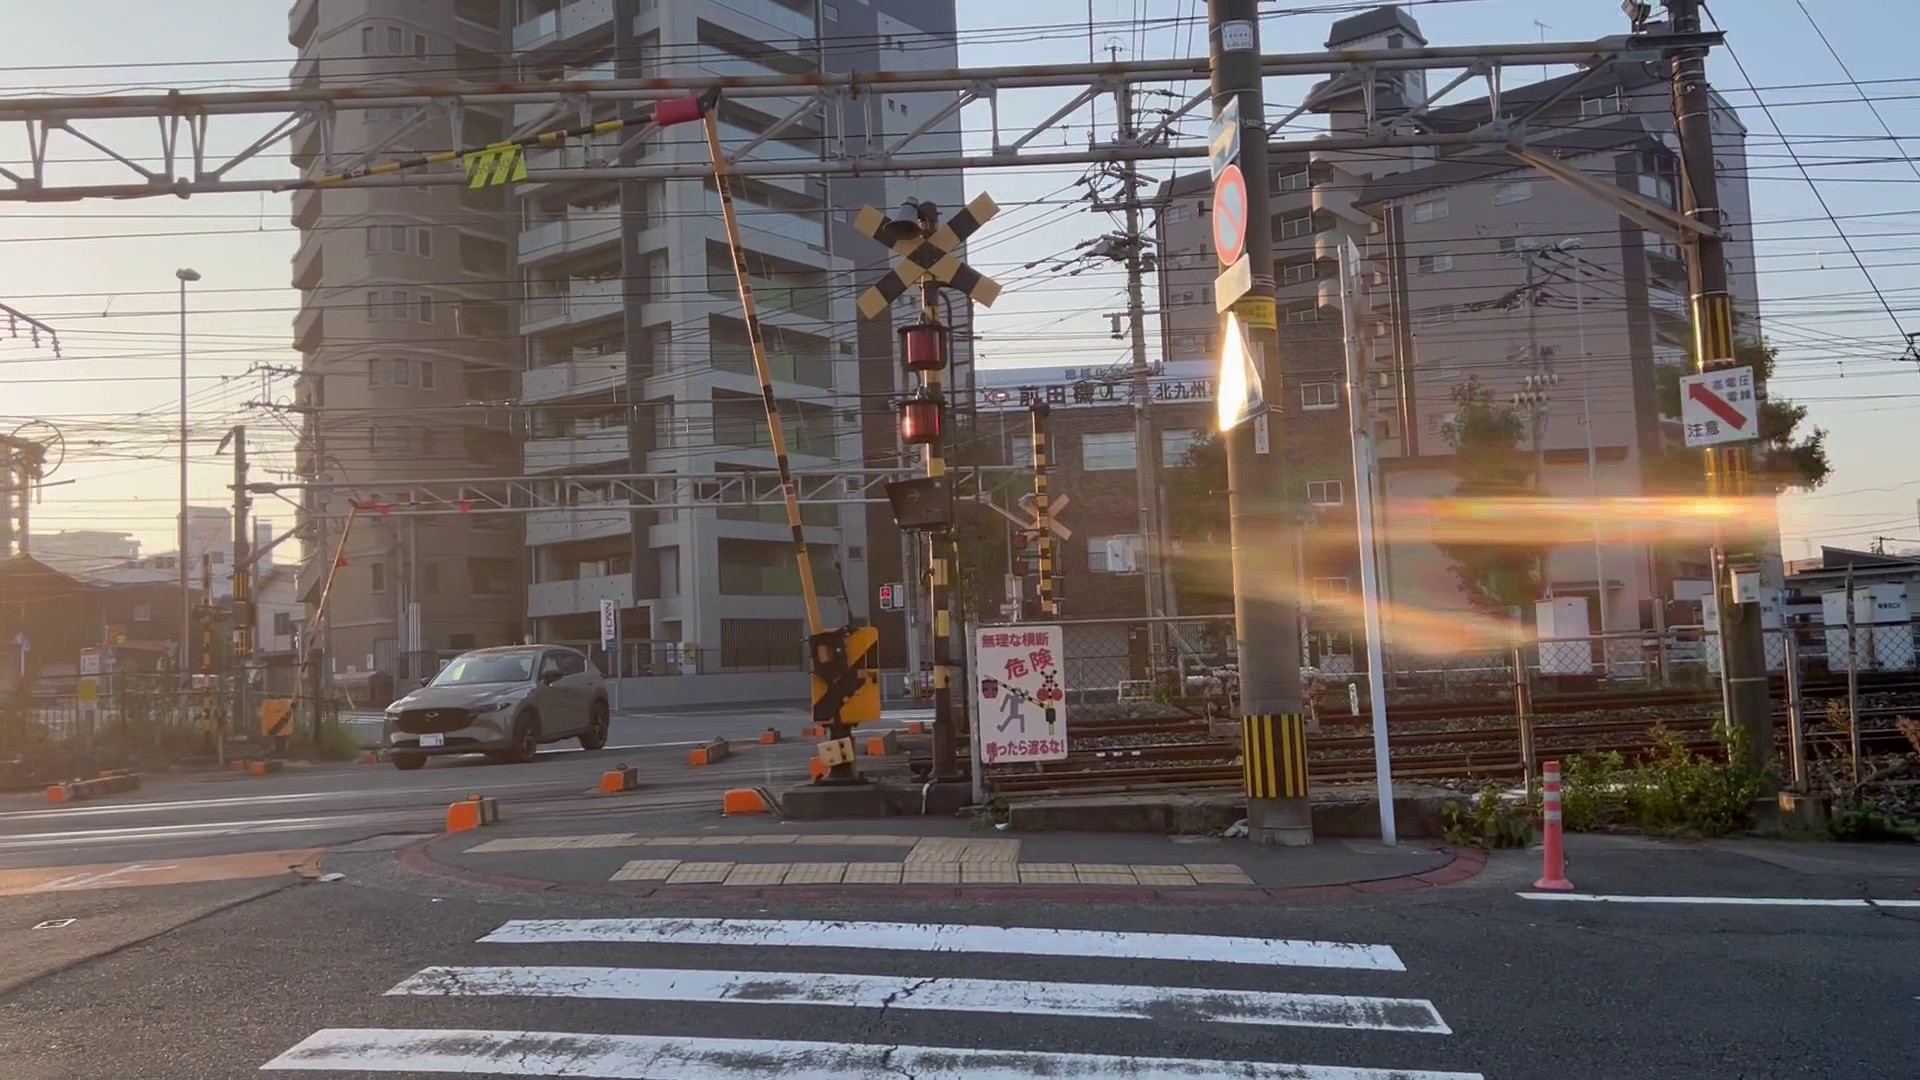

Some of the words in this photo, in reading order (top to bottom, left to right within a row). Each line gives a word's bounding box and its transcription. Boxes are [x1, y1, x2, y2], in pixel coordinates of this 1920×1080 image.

[1156, 380, 1214, 399] 北九州
[605, 602, 613, 635] NACHI
[982, 632, 1049, 648] 無理な横断
[1004, 648, 1055, 681] 危険
